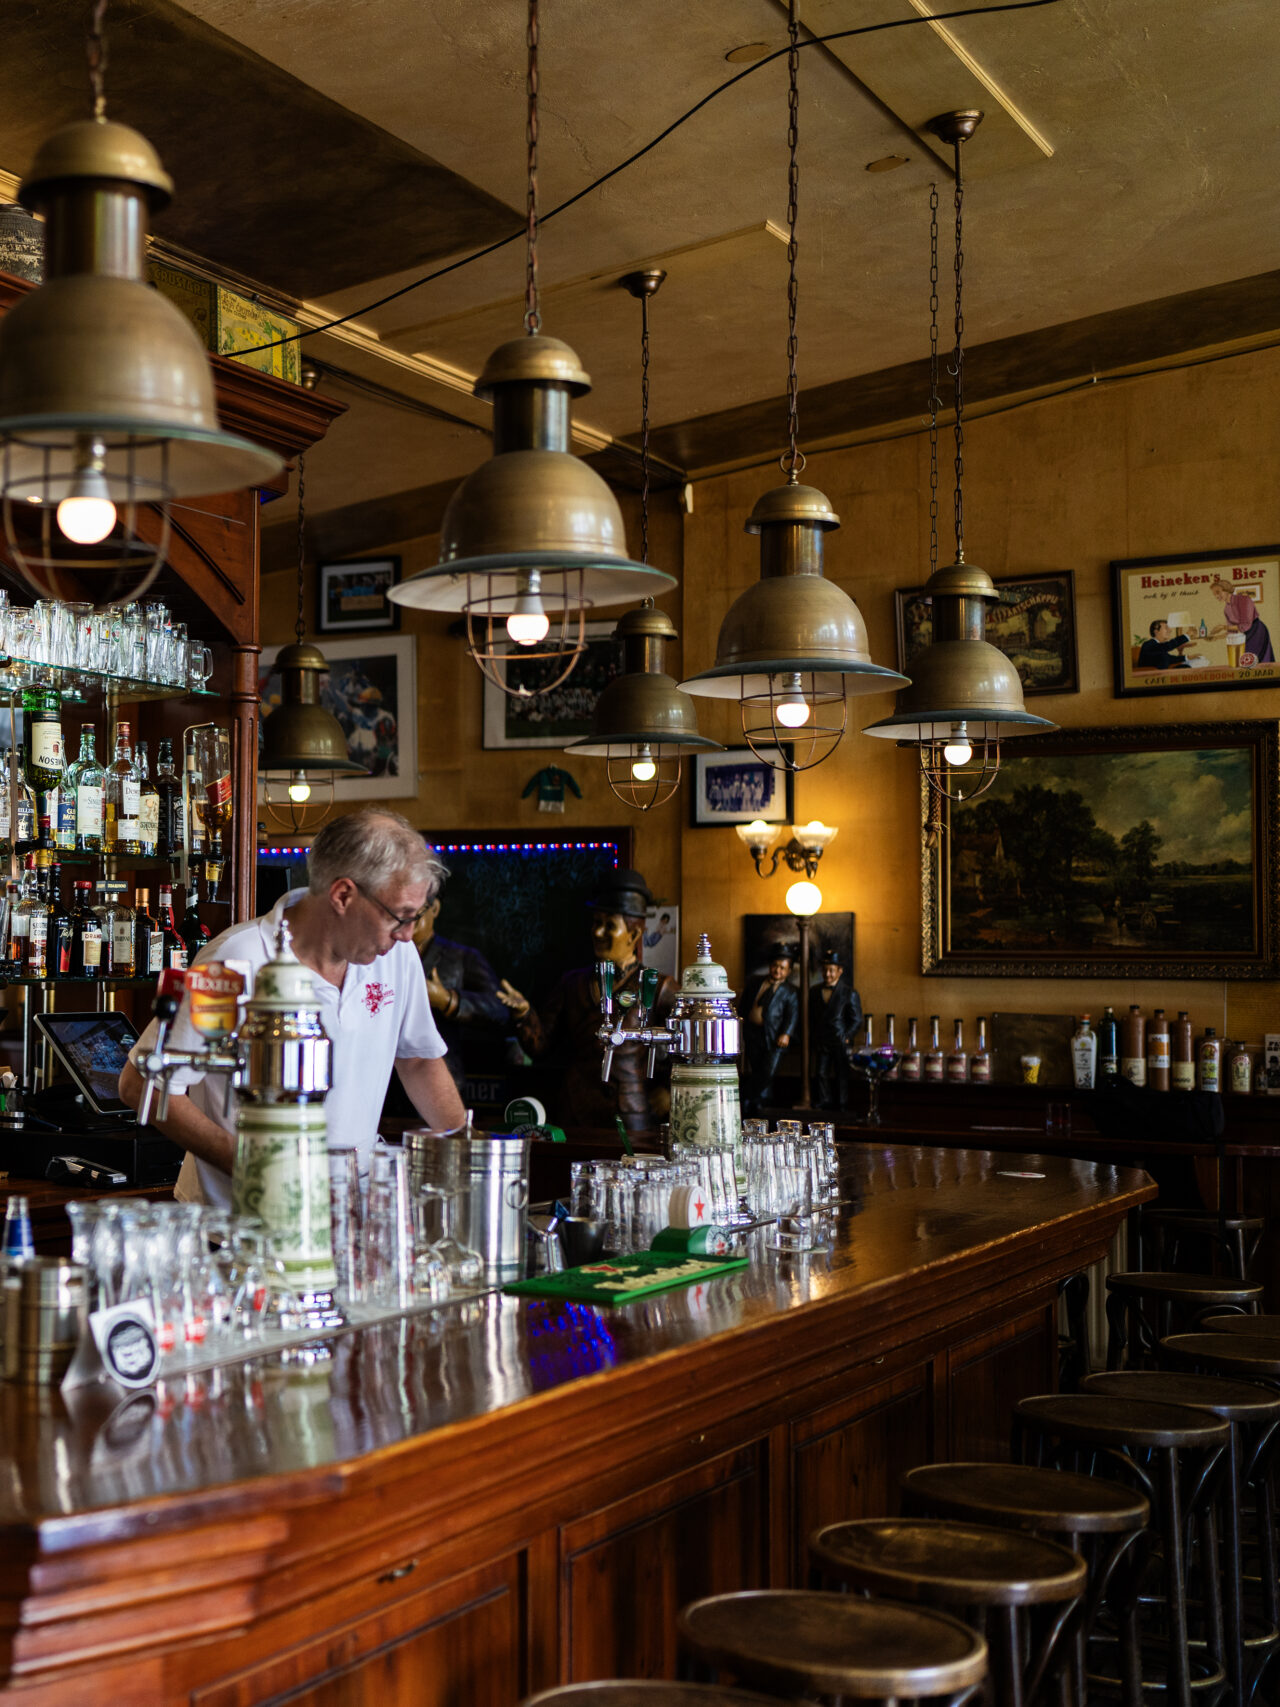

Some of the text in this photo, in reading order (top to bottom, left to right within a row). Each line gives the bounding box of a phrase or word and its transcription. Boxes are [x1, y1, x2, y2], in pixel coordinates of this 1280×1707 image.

[1141, 567, 1267, 589] Heineken's Bier
[187, 971, 242, 994] TEXELS
